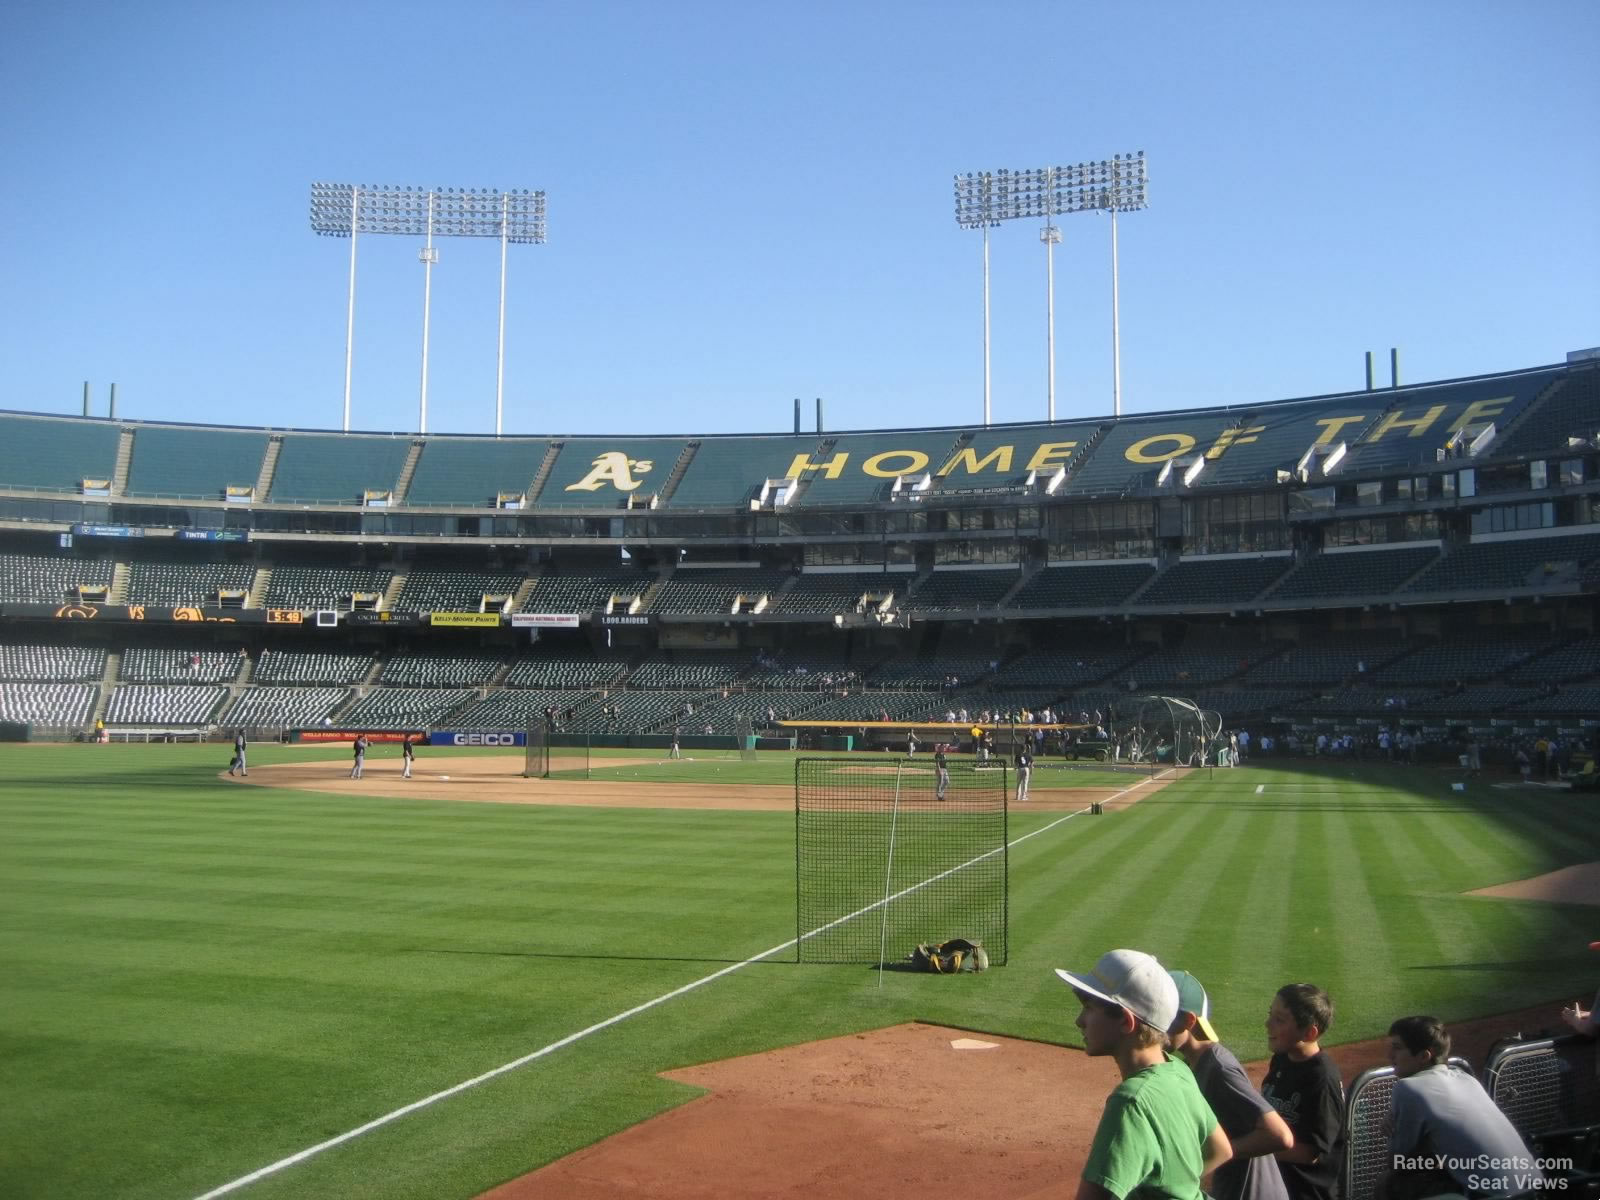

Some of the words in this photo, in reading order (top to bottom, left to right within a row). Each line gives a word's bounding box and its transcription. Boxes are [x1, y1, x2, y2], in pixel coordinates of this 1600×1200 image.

[784, 441, 1078, 480] HOME
[1124, 425, 1266, 464] OF
[1313, 395, 1515, 446] THE
[129, 607, 145, 620] VS
[274, 611, 300, 621] 5:49
[453, 733, 514, 745] GEICO
